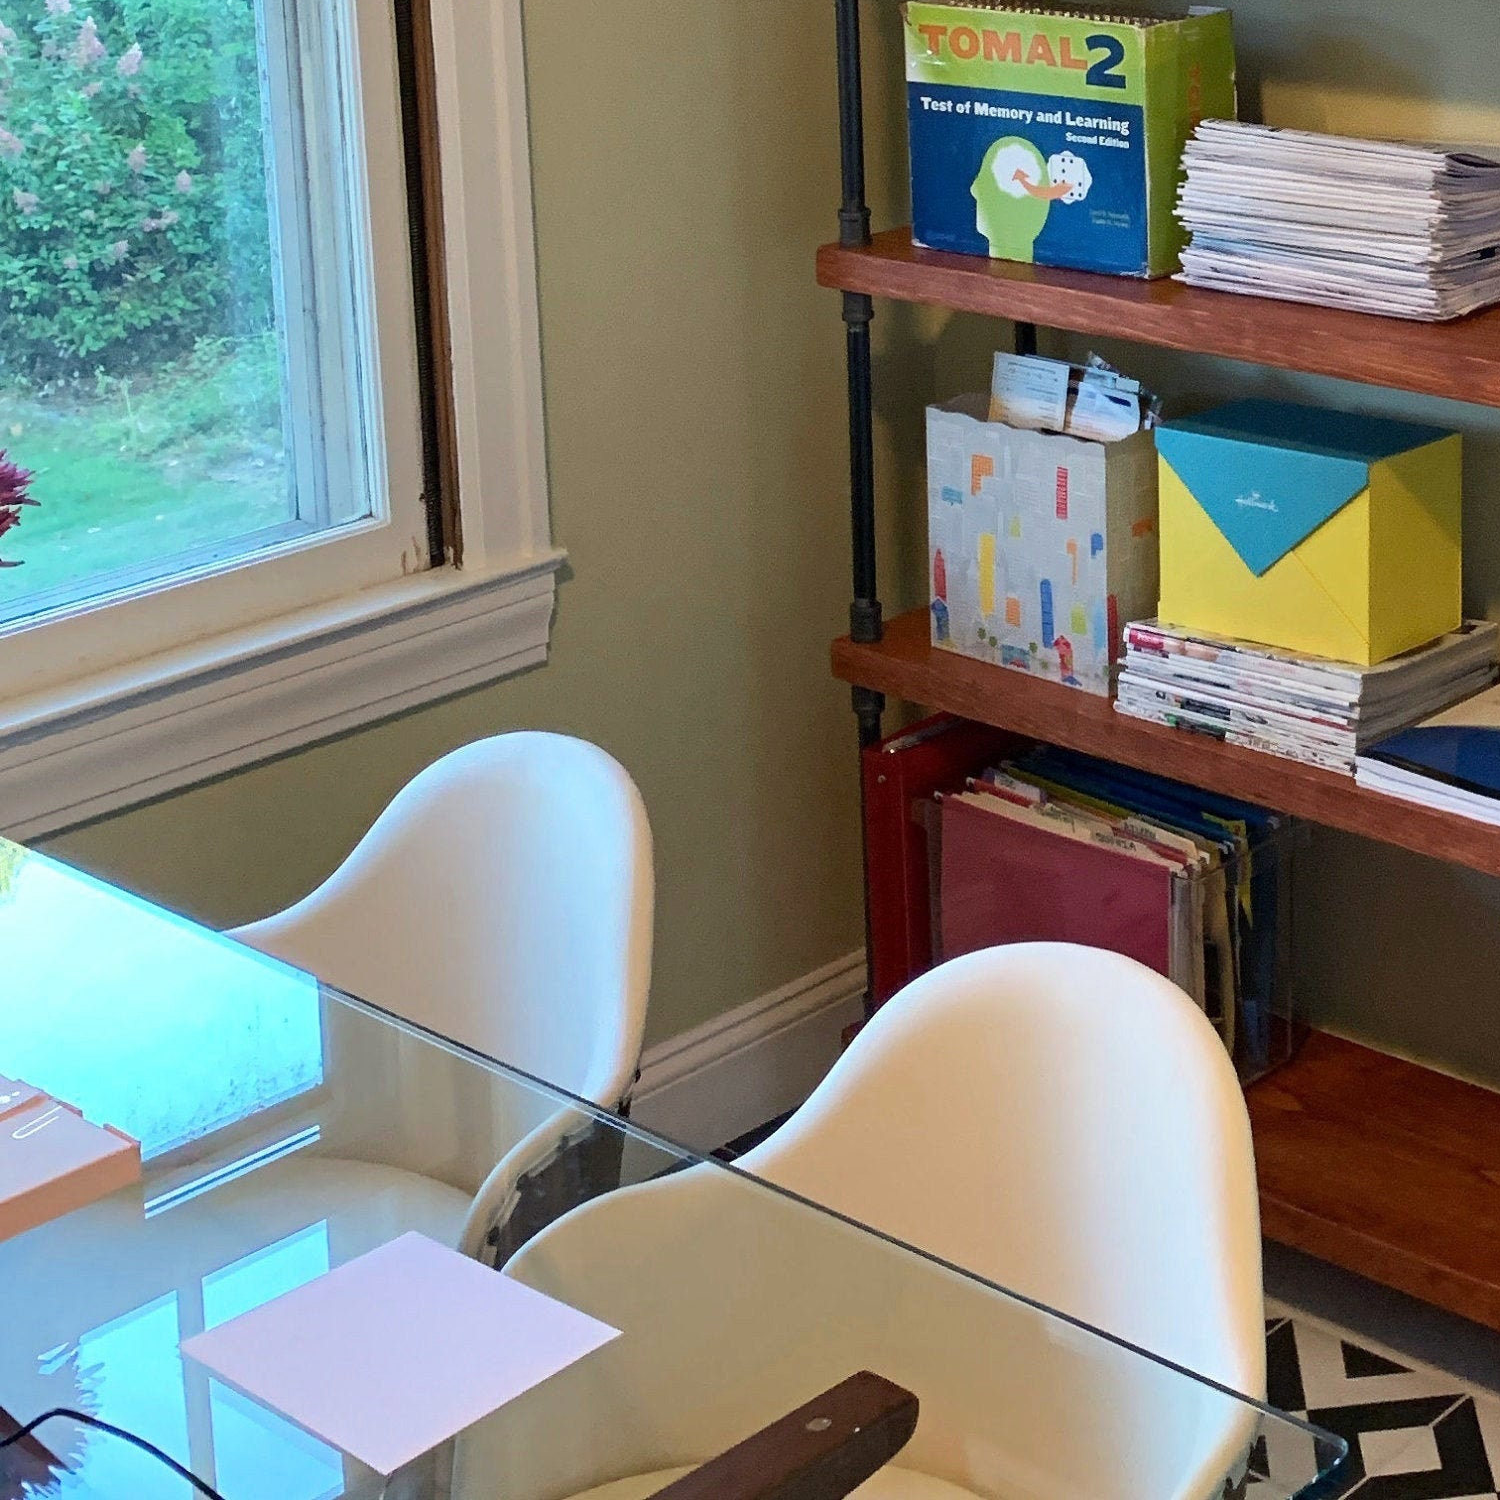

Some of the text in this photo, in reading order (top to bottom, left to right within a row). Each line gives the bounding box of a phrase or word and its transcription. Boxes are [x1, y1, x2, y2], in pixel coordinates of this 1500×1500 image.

[920, 96, 1130, 136] Test of Memory and Learning
[1065, 131, 1130, 149] Second Edition
